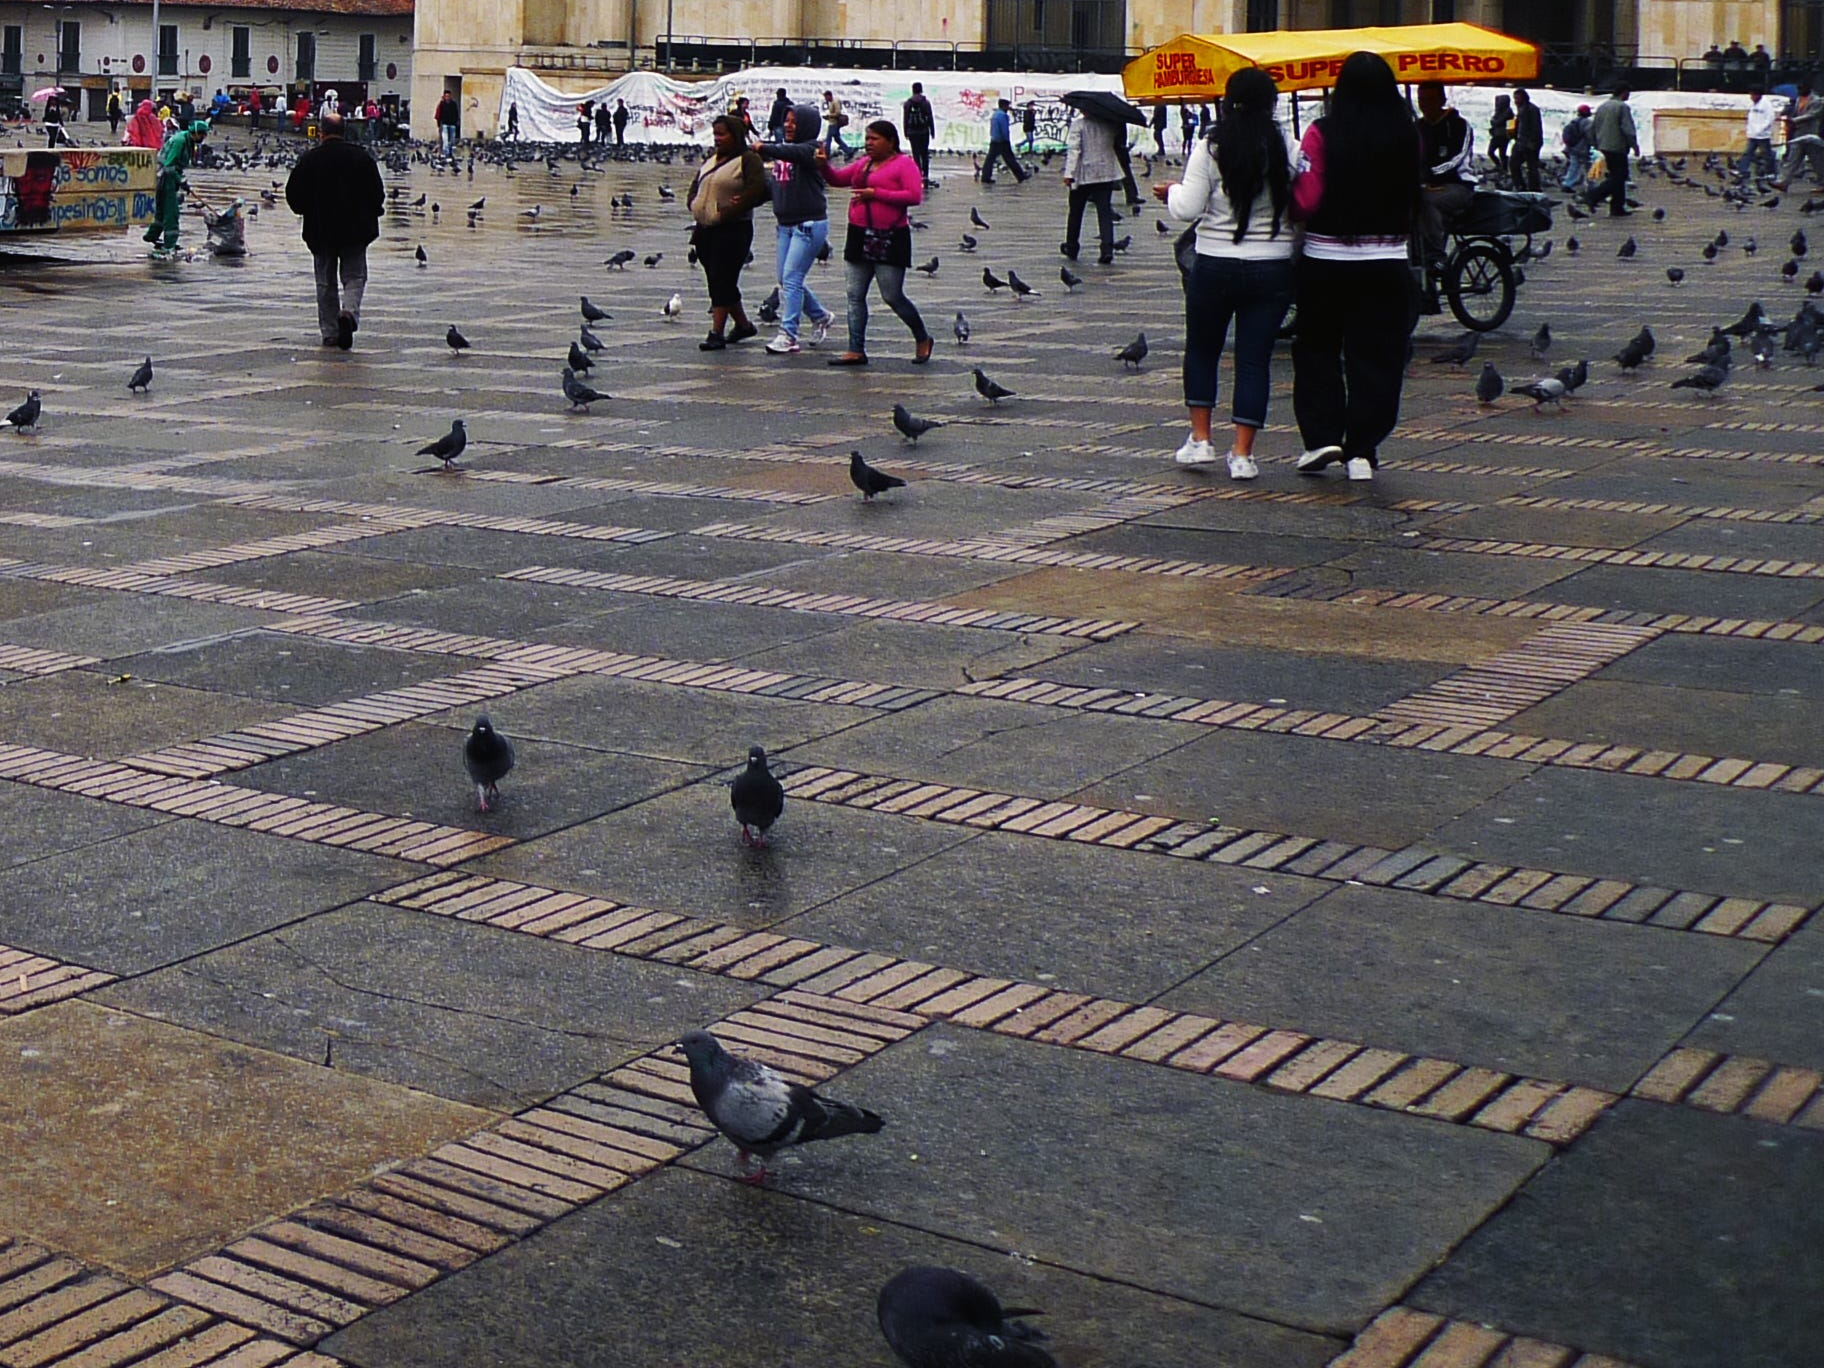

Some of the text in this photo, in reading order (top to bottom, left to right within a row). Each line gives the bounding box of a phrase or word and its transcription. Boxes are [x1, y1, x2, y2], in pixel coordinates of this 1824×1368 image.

[1156, 53, 1195, 70] SUPER
[1265, 53, 1505, 83] SUPE PERRO
